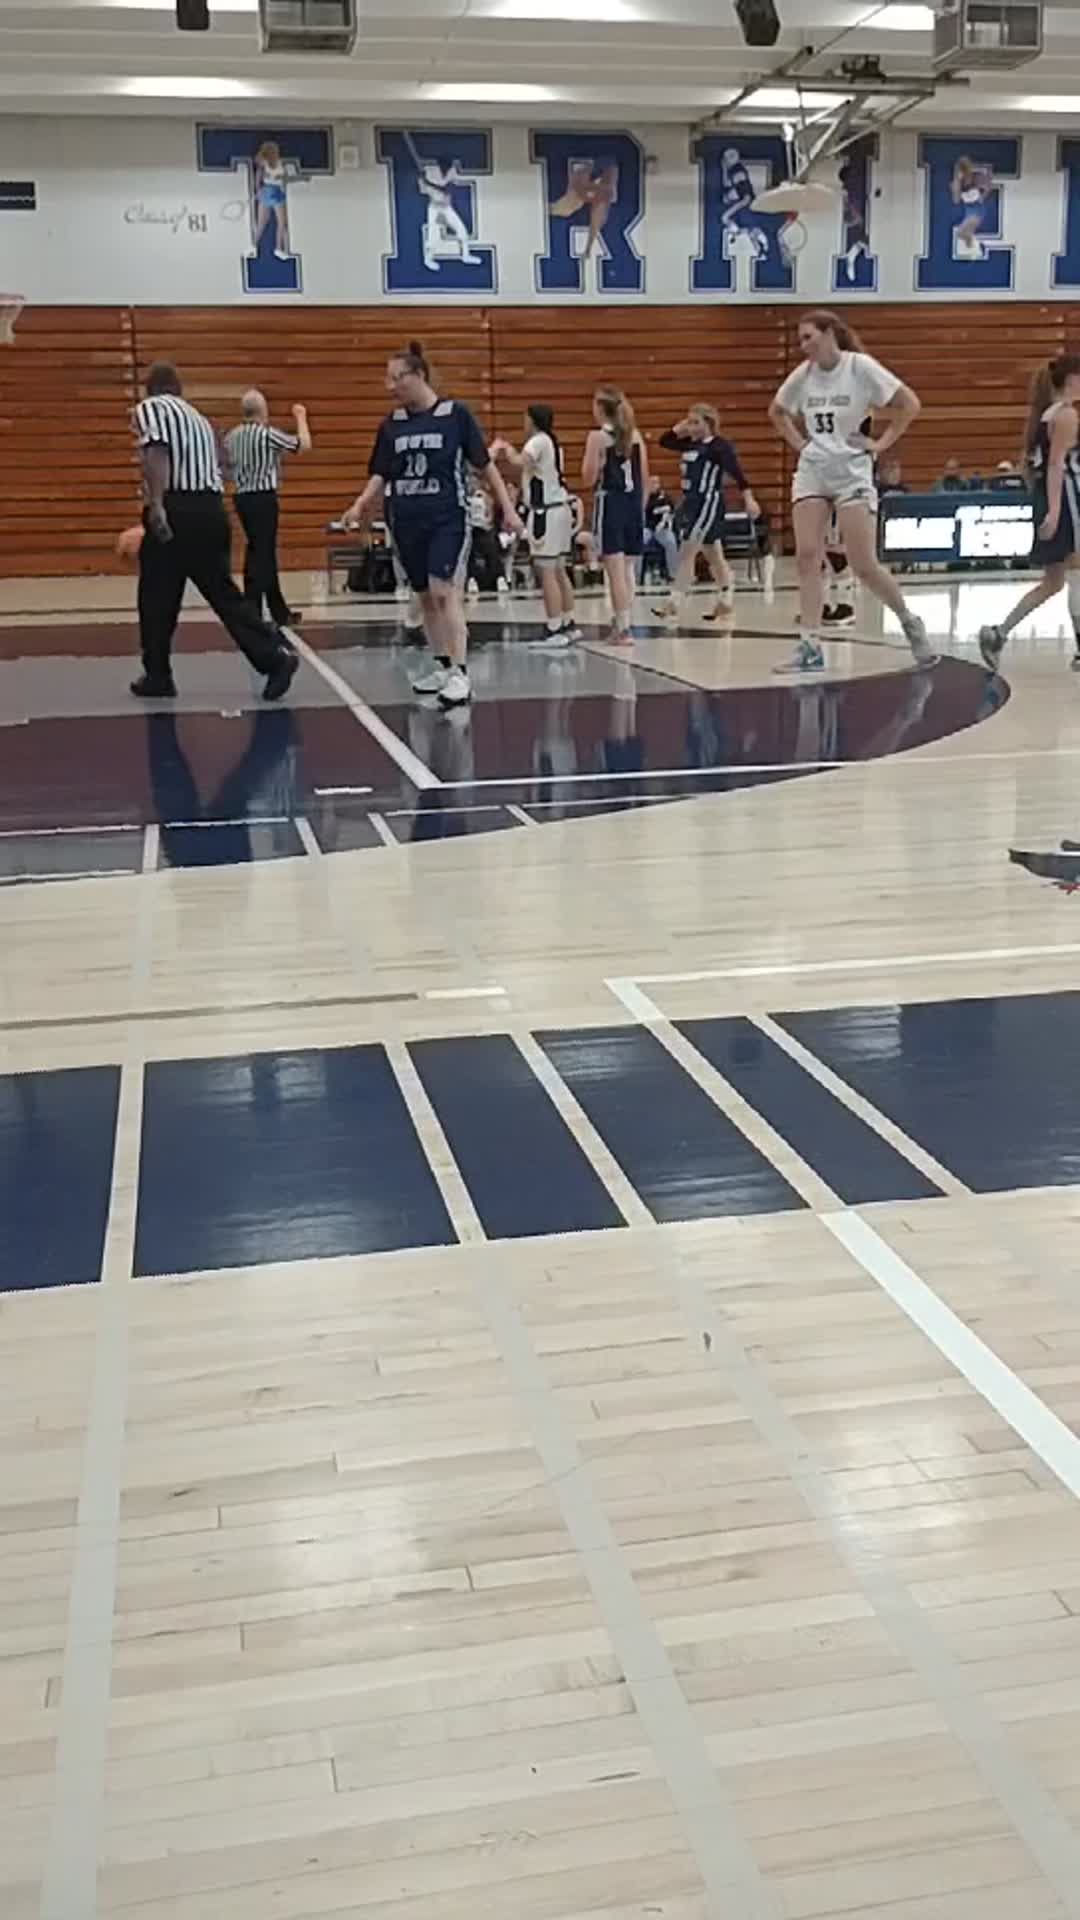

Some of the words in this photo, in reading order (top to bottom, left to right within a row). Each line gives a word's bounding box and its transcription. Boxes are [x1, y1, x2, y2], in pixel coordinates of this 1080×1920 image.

[196, 122, 1080, 294] TERRIE
[814, 411, 835, 434] 33
[620, 458, 635, 493] 1
